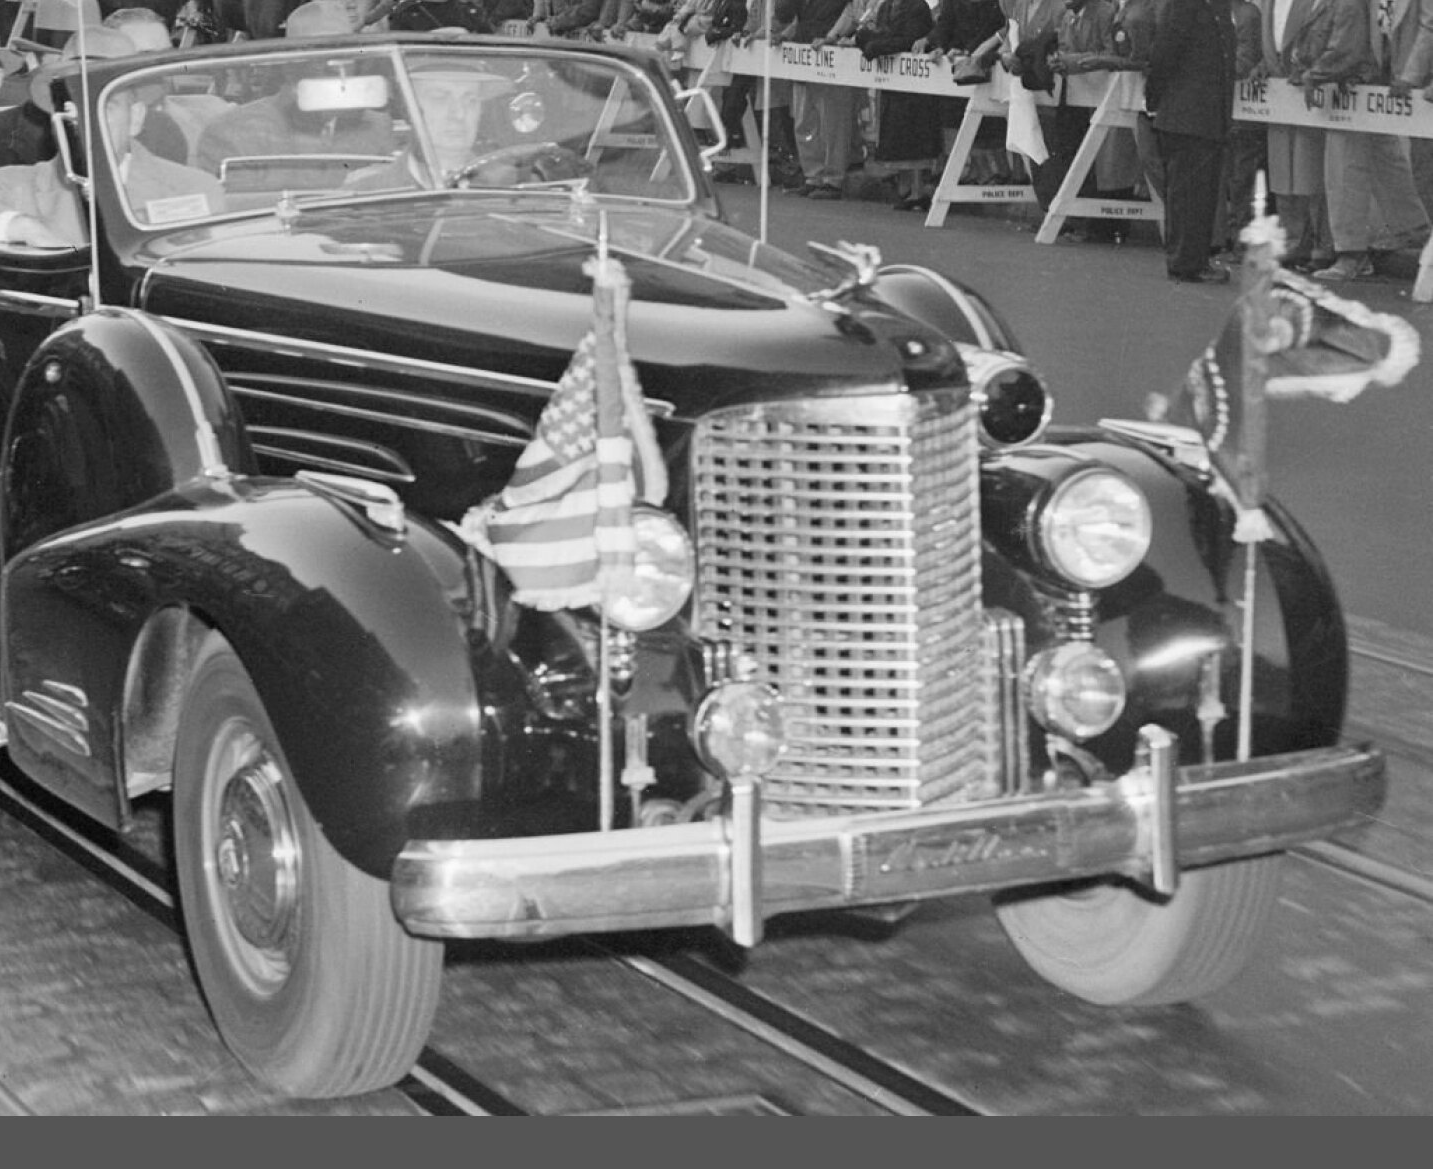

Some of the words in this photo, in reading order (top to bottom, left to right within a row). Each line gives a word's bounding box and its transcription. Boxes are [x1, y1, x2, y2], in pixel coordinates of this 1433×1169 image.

[782, 45, 812, 68] POLICE
[815, 49, 835, 69] LINE
[877, 54, 895, 74] NOT
[899, 57, 930, 78] CROSS
[1239, 81, 1267, 103] LINE
[1331, 88, 1358, 111] NOT
[1366, 91, 1413, 117] CROSS
[982, 190, 1006, 199] POLICE
